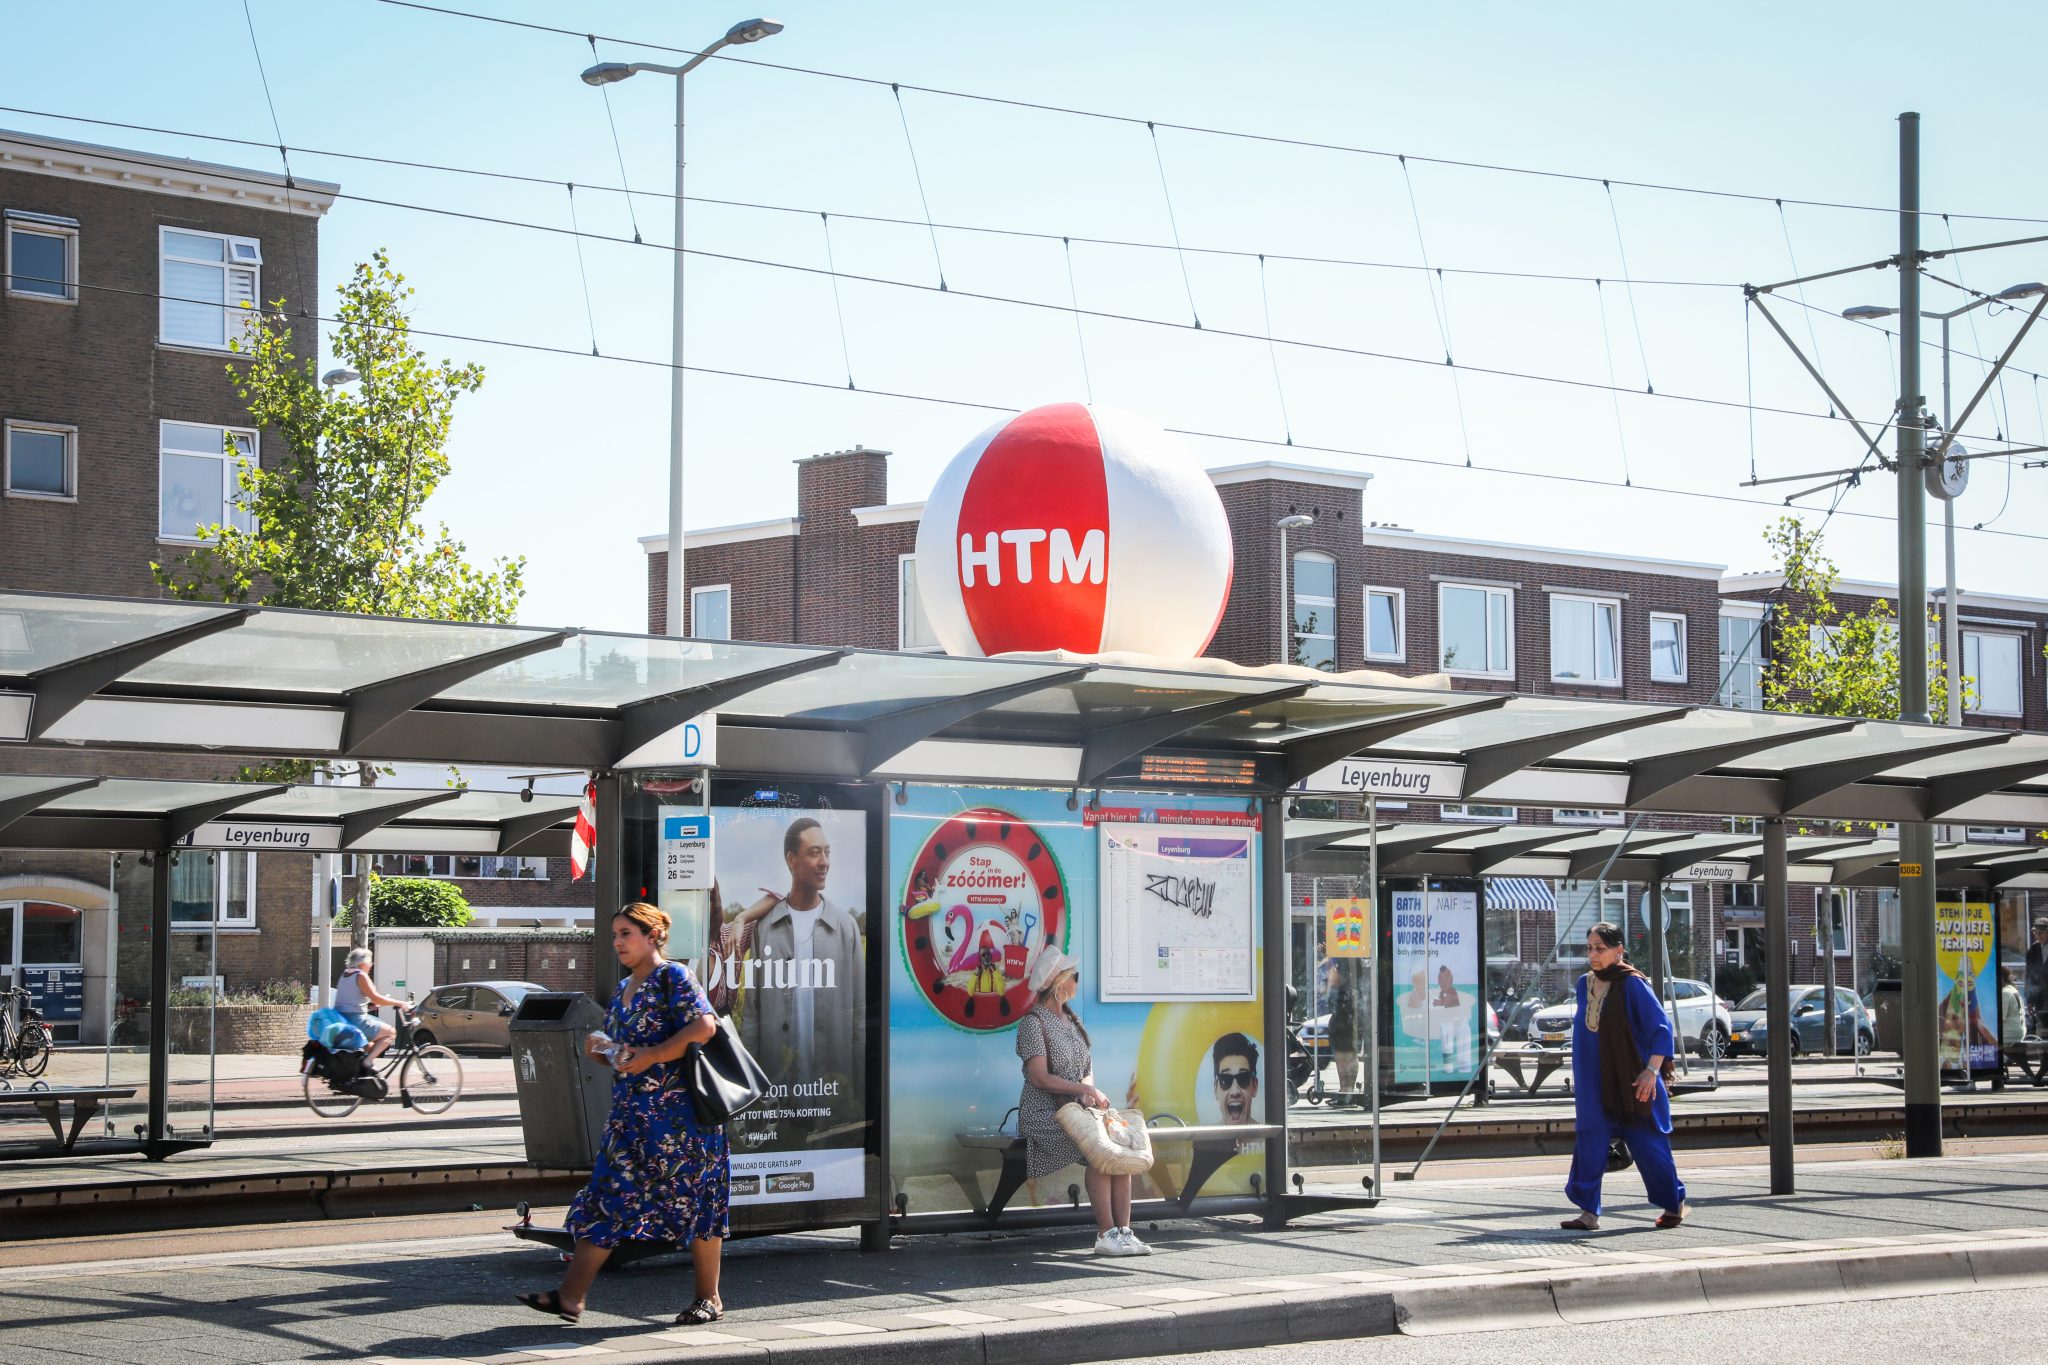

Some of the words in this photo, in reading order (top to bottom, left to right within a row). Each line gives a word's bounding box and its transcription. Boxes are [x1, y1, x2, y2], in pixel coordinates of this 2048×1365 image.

[961, 528, 1106, 588] HTM
[684, 724, 701, 757] D
[1341, 766, 1431, 793] Leyenburg
[1084, 811, 1109, 822] Vanaf
[1110, 812, 1128, 822] hier
[1129, 813, 1138, 822] in
[1141, 811, 1156, 822] 14
[1160, 814, 1193, 824] minuten
[1195, 817, 1214, 825] naar
[1216, 816, 1229, 826] het
[1231, 817, 1259, 827] strand!
[225, 827, 310, 847] Leyenburg
[680, 841, 706, 849] Leyenburg
[1161, 846, 1191, 855] Leyenburg
[668, 854, 677, 864] 23
[970, 857, 992, 868] Stap
[668, 870, 677, 880] 26
[1690, 865, 1734, 880] Leyenburg
[947, 870, 1027, 888] zóóómer!
[1396, 897, 1422, 911] BATH
[1940, 908, 1960, 918] STEM
[1973, 909, 1983, 918] JE
[1397, 948, 1410, 957] baby
[793, 1078, 839, 1096] outlet
[748, 1111, 762, 1120] TOT
[762, 1109, 778, 1119] WEL
[780, 1109, 796, 1118] 75%
[796, 1107, 832, 1117] KORTING
[748, 1131, 778, 1141] #WearIt
[730, 1162, 758, 1170] WNLOAD
[759, 1161, 767, 1169] DE
[768, 1160, 789, 1168] GRATIS
[789, 1159, 802, 1167] APP
[738, 1184, 754, 1192] Store
[779, 1181, 799, 1191] Google
[799, 1181, 812, 1189] Play
